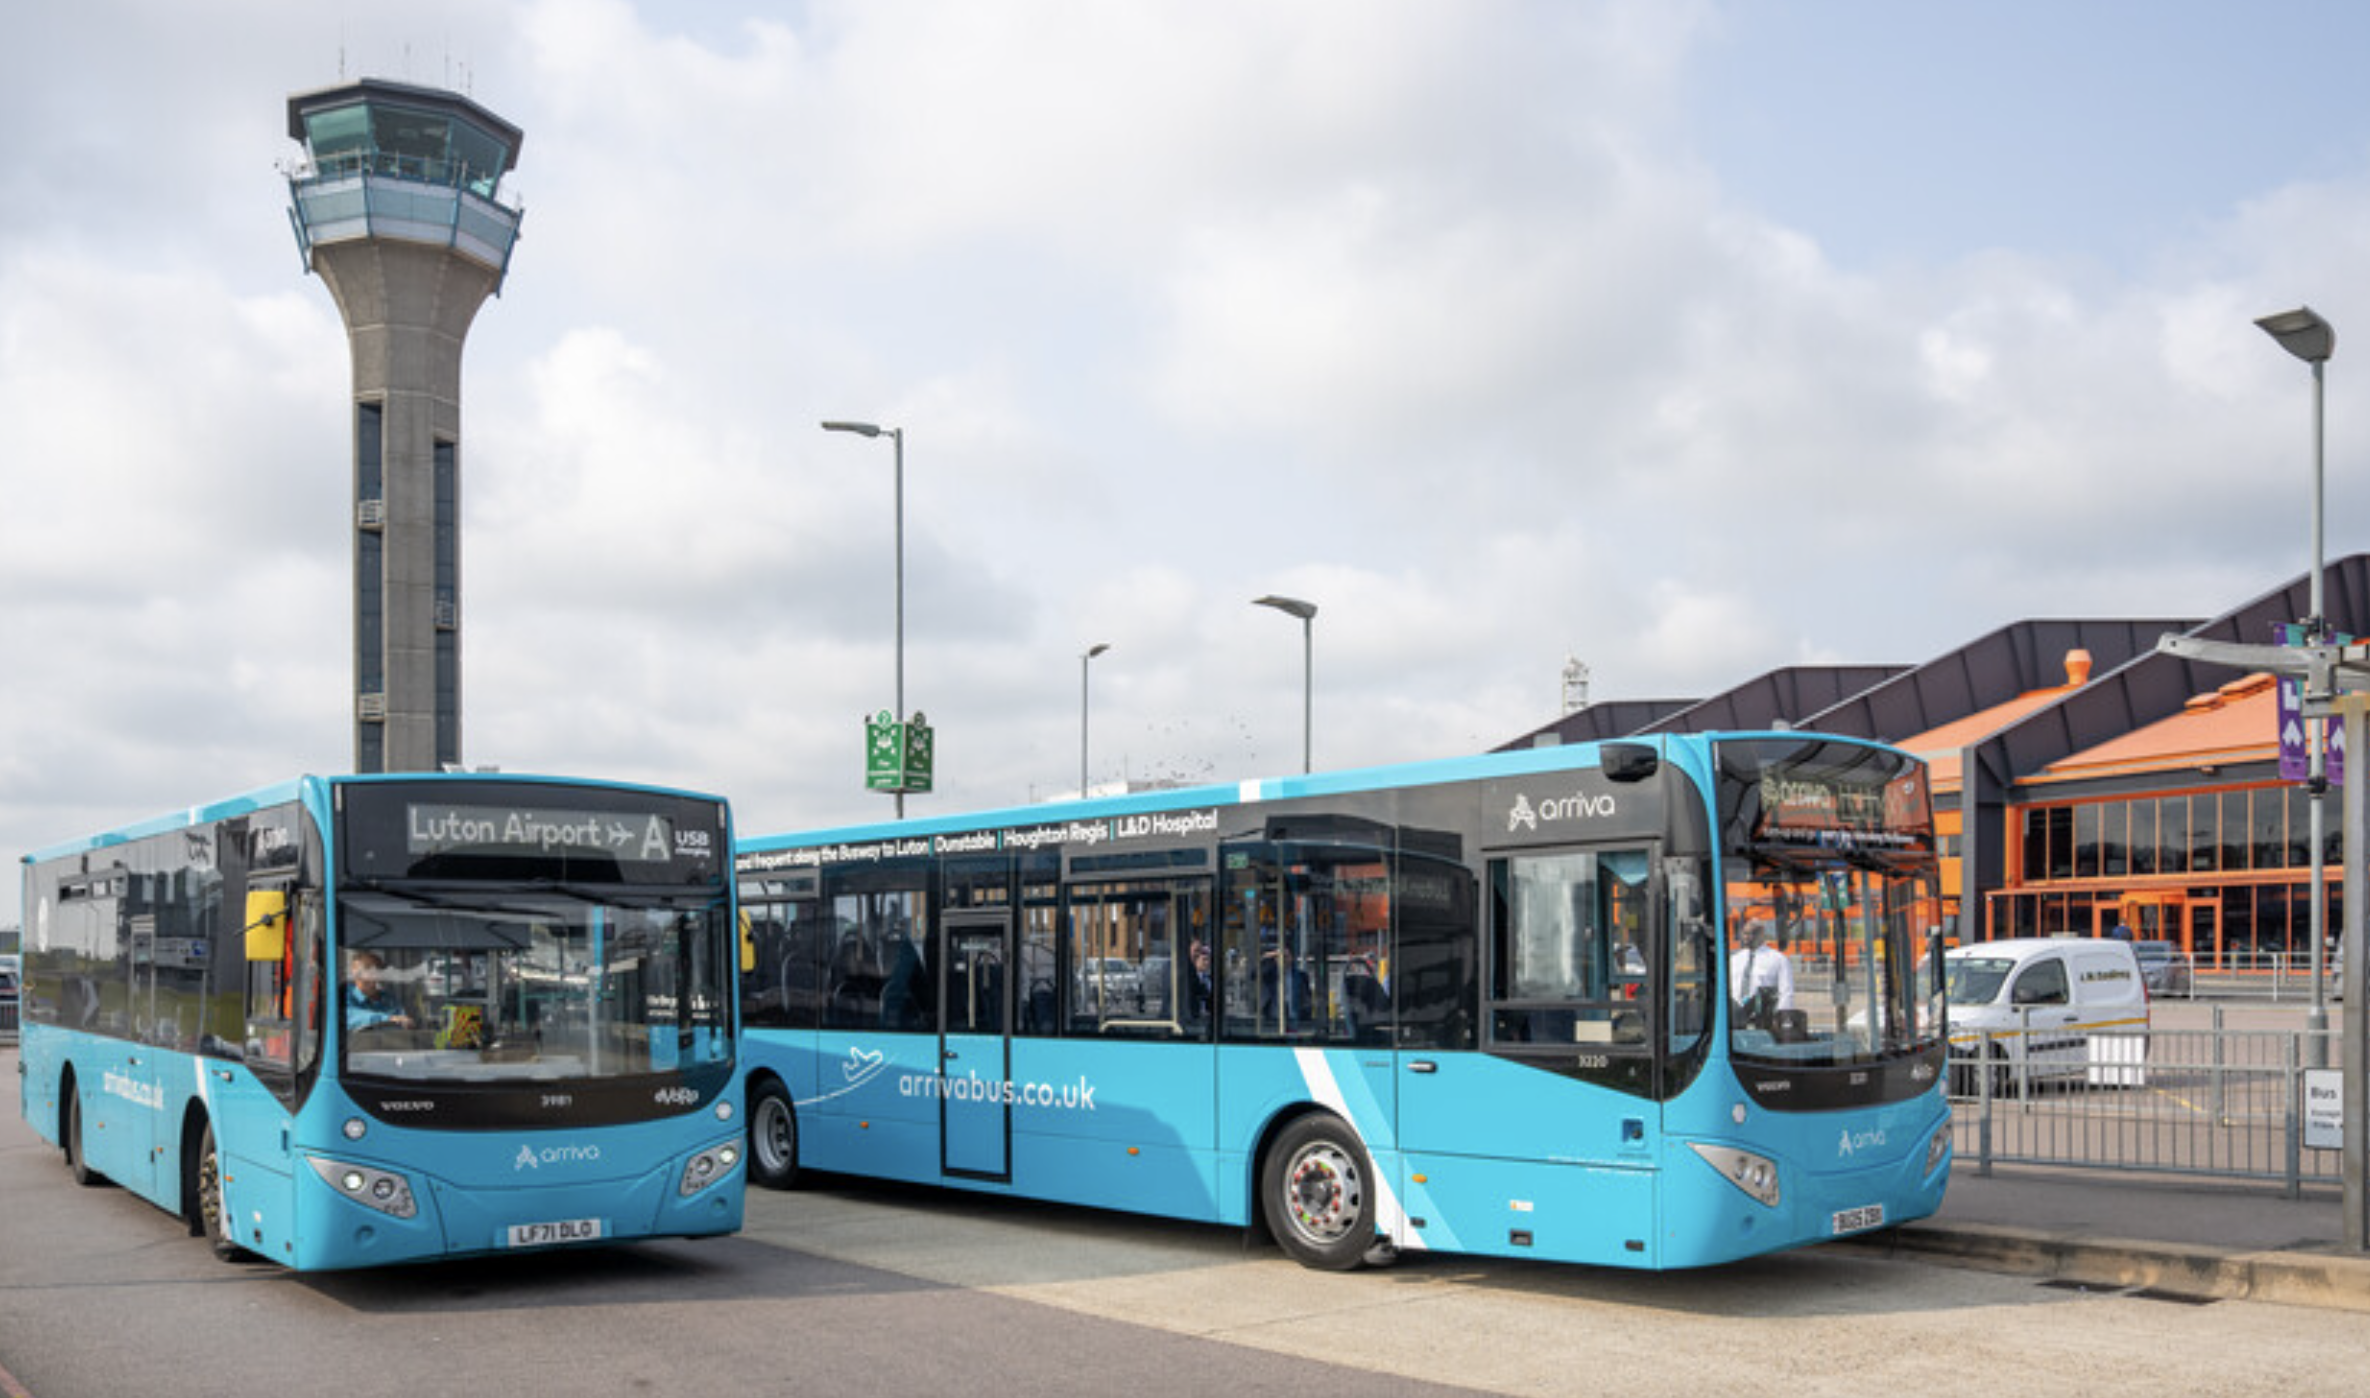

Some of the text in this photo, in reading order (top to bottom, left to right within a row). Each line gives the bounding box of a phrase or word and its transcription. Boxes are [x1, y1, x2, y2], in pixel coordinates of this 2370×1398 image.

[1539, 791, 1616, 820] arriva
[410, 806, 671, 861] Luton Airport A
[674, 829, 709, 847] USB
[897, 838, 929, 857] Luton
[934, 830, 996, 852] Dunstable
[1003, 825, 1067, 849] Houghton
[1069, 819, 1108, 846] Regis
[1118, 816, 1150, 837] L&D
[1153, 808, 1218, 837] Hospital
[899, 1068, 1097, 1110] arrivabus.co.uk
[381, 1100, 434, 1111] VOLVO
[540, 1145, 600, 1164] arriva
